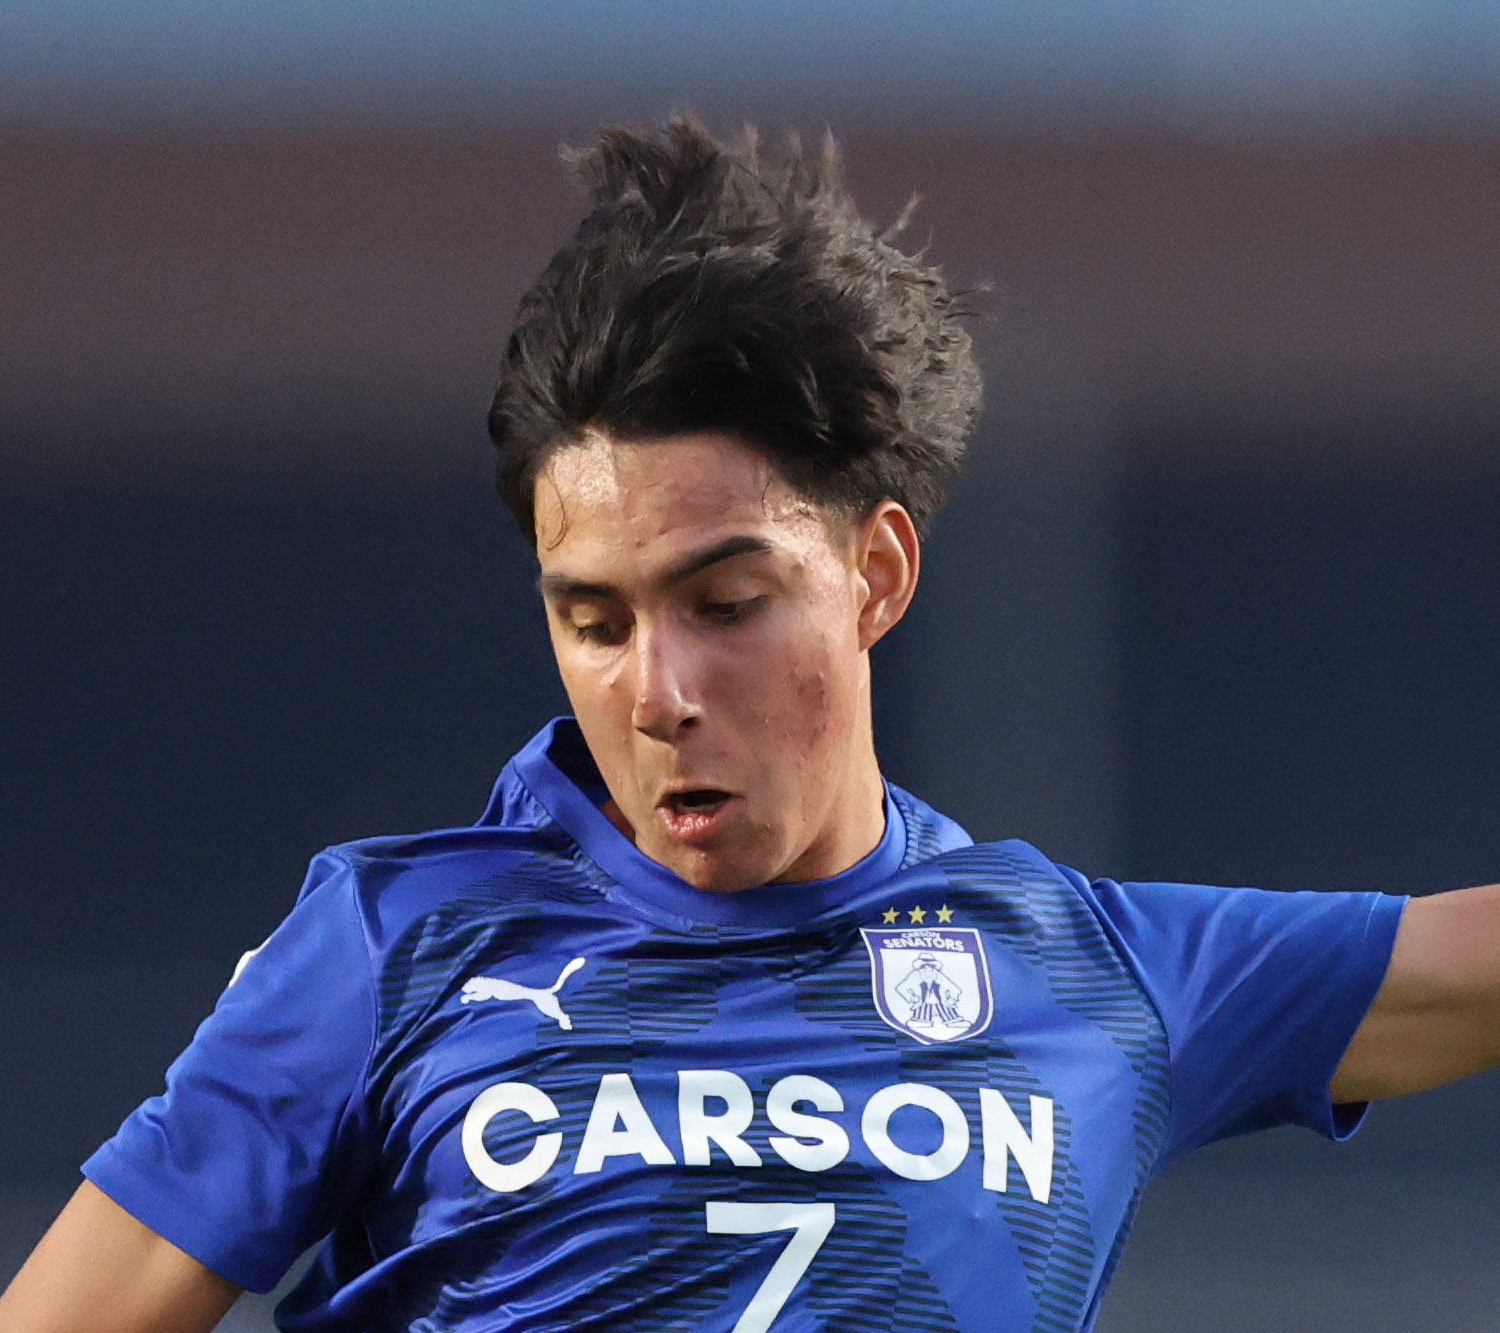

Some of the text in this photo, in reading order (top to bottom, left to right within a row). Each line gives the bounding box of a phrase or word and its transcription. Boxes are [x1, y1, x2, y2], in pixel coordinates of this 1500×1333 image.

[901, 931, 941, 939] CARSON
[883, 938, 965, 952] SENATORS
[461, 1070, 1055, 1205] CARSON
